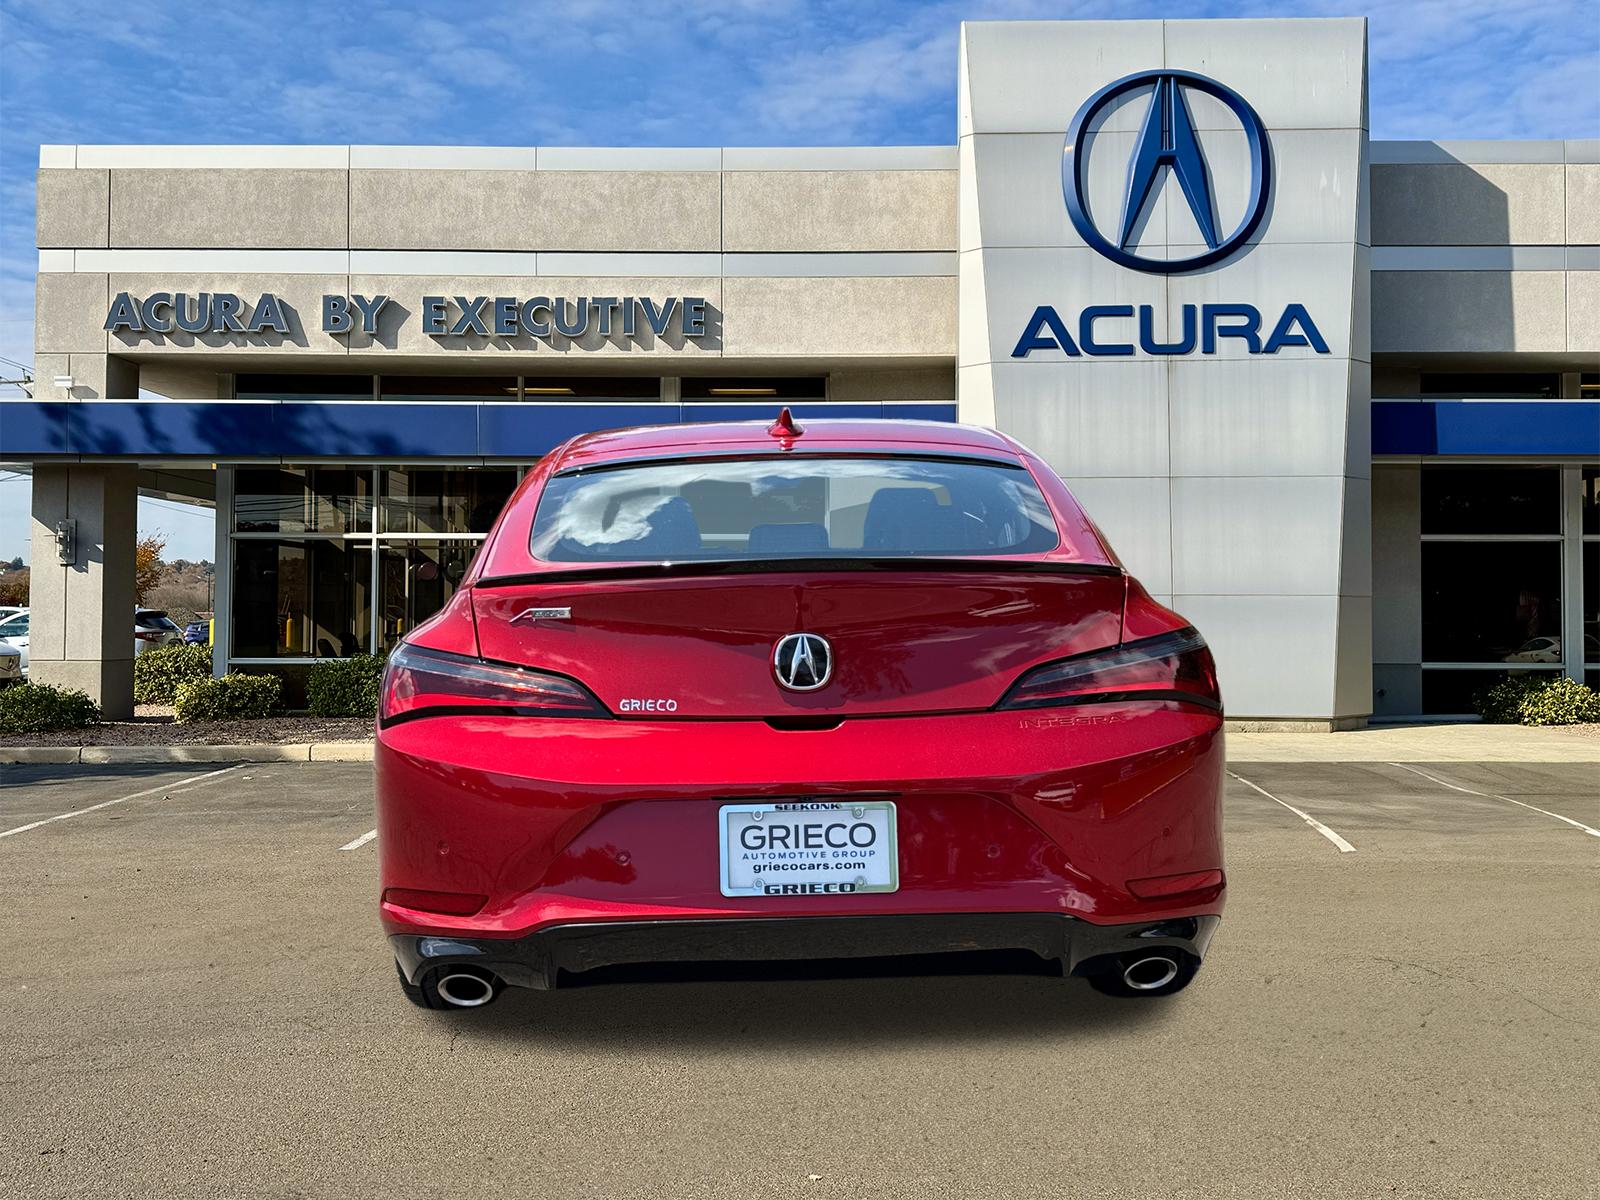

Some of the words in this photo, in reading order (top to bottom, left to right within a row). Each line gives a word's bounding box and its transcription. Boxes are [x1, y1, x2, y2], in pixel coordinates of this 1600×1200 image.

[104, 292, 288, 332] ACURA
[322, 294, 391, 332] BY
[423, 296, 706, 336] EXECUTIVE
[1010, 303, 1331, 356] ACURA
[619, 699, 677, 711] GRIECO
[1019, 716, 1122, 728] INTEGRA
[775, 803, 841, 811] SEEKONK
[740, 823, 876, 850] GRIECO
[742, 851, 827, 860] AUTOMOTIVE
[832, 850, 876, 858] GROUP
[753, 861, 866, 873] griecocars.com
[764, 882, 856, 894] GRIECO
